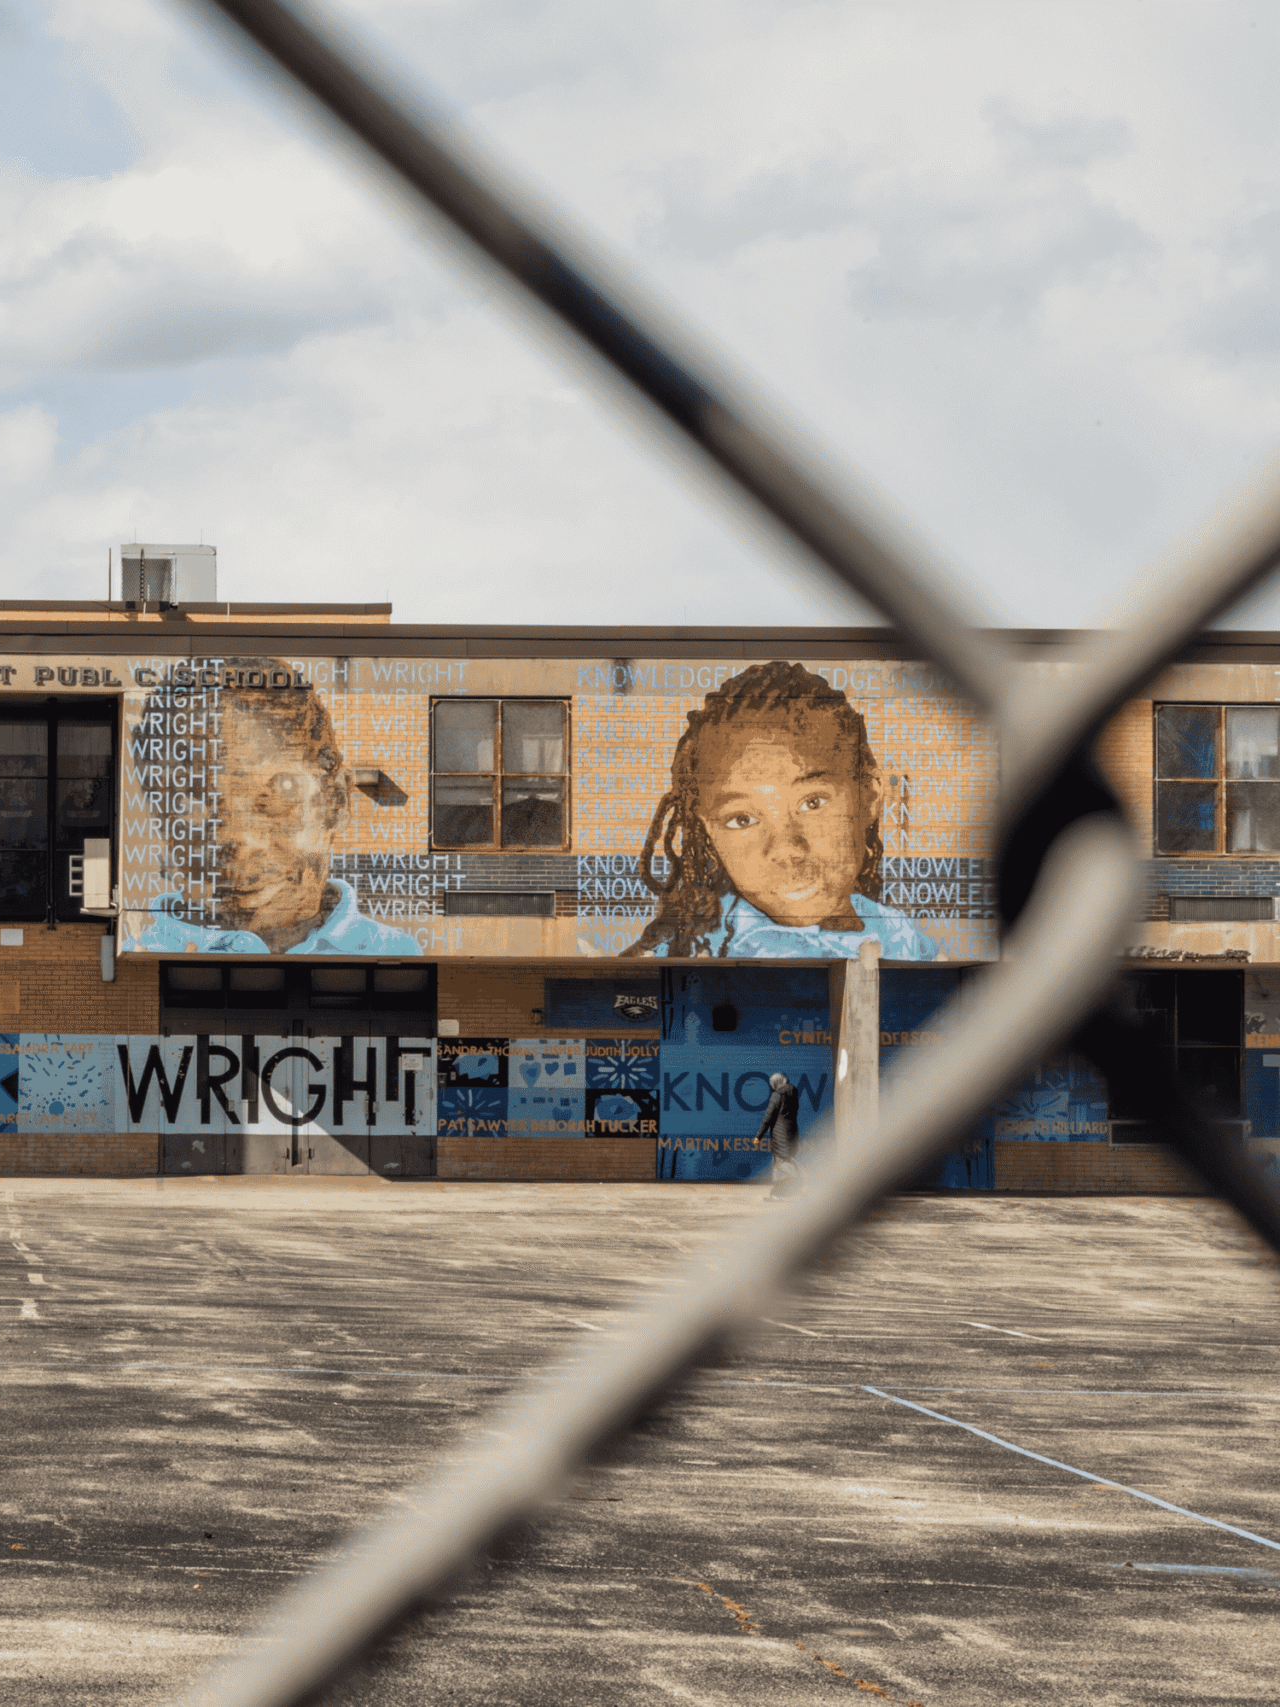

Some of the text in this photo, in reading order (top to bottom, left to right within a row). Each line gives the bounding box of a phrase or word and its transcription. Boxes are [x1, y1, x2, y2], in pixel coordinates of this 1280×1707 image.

[172, 667, 314, 691] SCHOOL
[292, 661, 365, 684] RIGHT
[371, 661, 469, 684] WRIGHT
[577, 665, 729, 689] KNOWLEDGE
[125, 738, 223, 761] WRIGHT
[124, 765, 223, 788] WRIGHT
[124, 791, 223, 814] WRIGHT
[124, 817, 223, 841] WRIGHT
[124, 844, 222, 867] WRIGHT
[123, 871, 222, 894] WRIGHT
[367, 873, 467, 897] WRIGHT
[613, 994, 659, 1010] EAGLES
[63, 1042, 94, 1055] TART
[778, 1030, 832, 1045] CYNTH
[436, 1045, 485, 1056] SANDRA
[585, 1046, 621, 1057] JUDITH
[625, 1046, 659, 1057] JOLLY
[116, 1034, 432, 1127] WRIGHT
[437, 1118, 658, 1133] PAT SAWYER DEBORAH TUCKER
[657, 1138, 771, 1151] MARTIN KESSE
